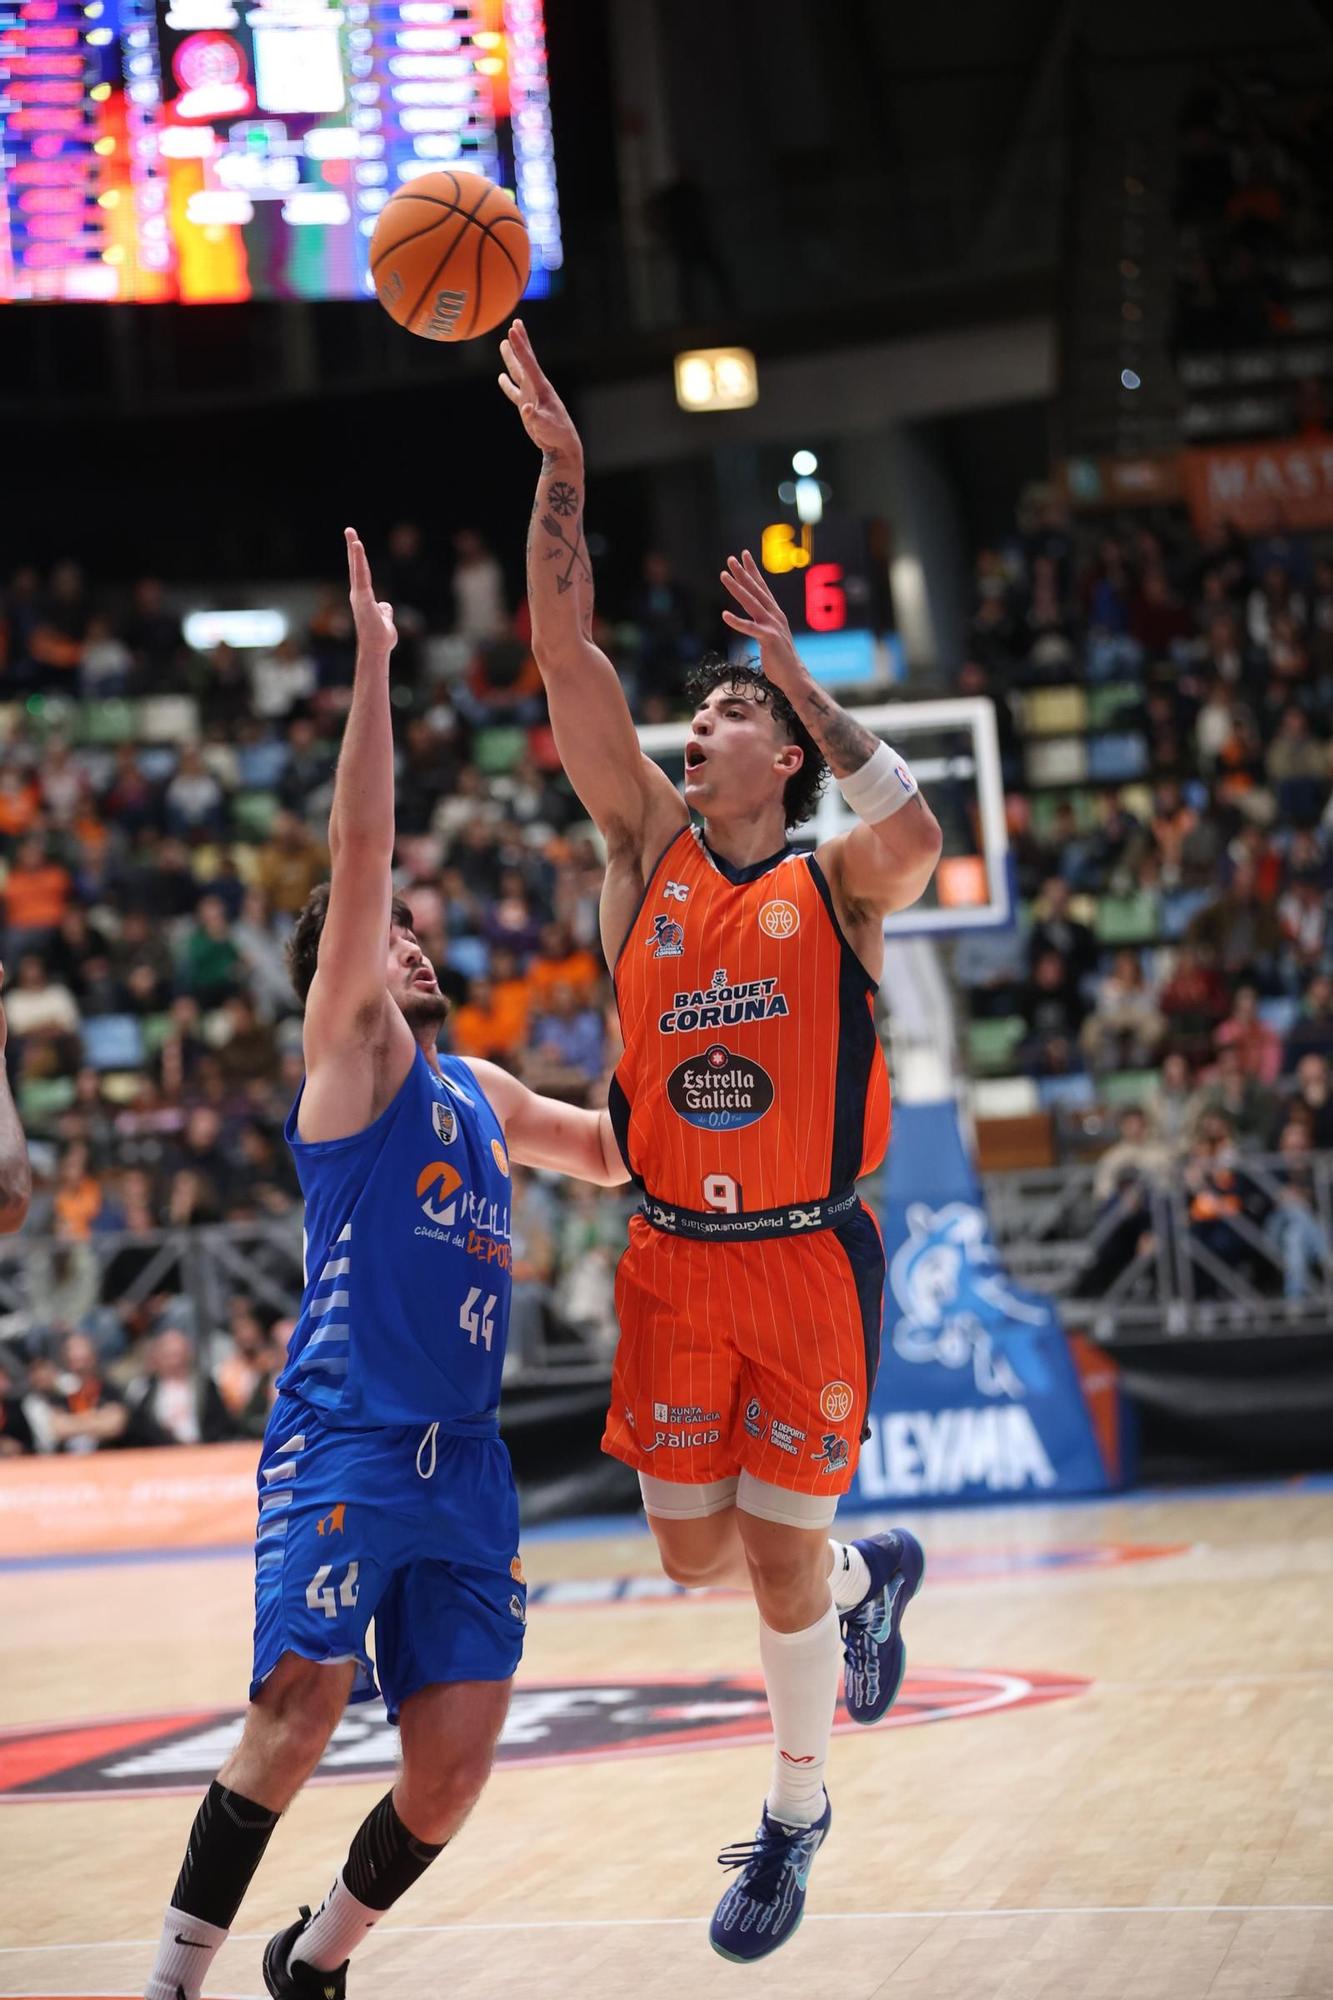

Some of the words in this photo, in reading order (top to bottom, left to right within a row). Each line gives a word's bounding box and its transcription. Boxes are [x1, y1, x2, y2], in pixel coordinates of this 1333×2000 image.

[805, 562, 847, 632] 6
[674, 977, 777, 1010] BASQUET
[682, 1069, 754, 1089] Estrella
[685, 1089, 752, 1109] Galicia
[703, 1173, 742, 1214] 9
[414, 1226, 451, 1243] ciudad
[452, 1234, 465, 1249] del
[460, 1286, 498, 1352] 44
[670, 1407, 703, 1415] XUNTA
[684, 1413, 721, 1423] GALICIA
[641, 1430, 720, 1452] galicia
[859, 1405, 1057, 1499] LEYMA
[306, 1560, 359, 1619] 44
